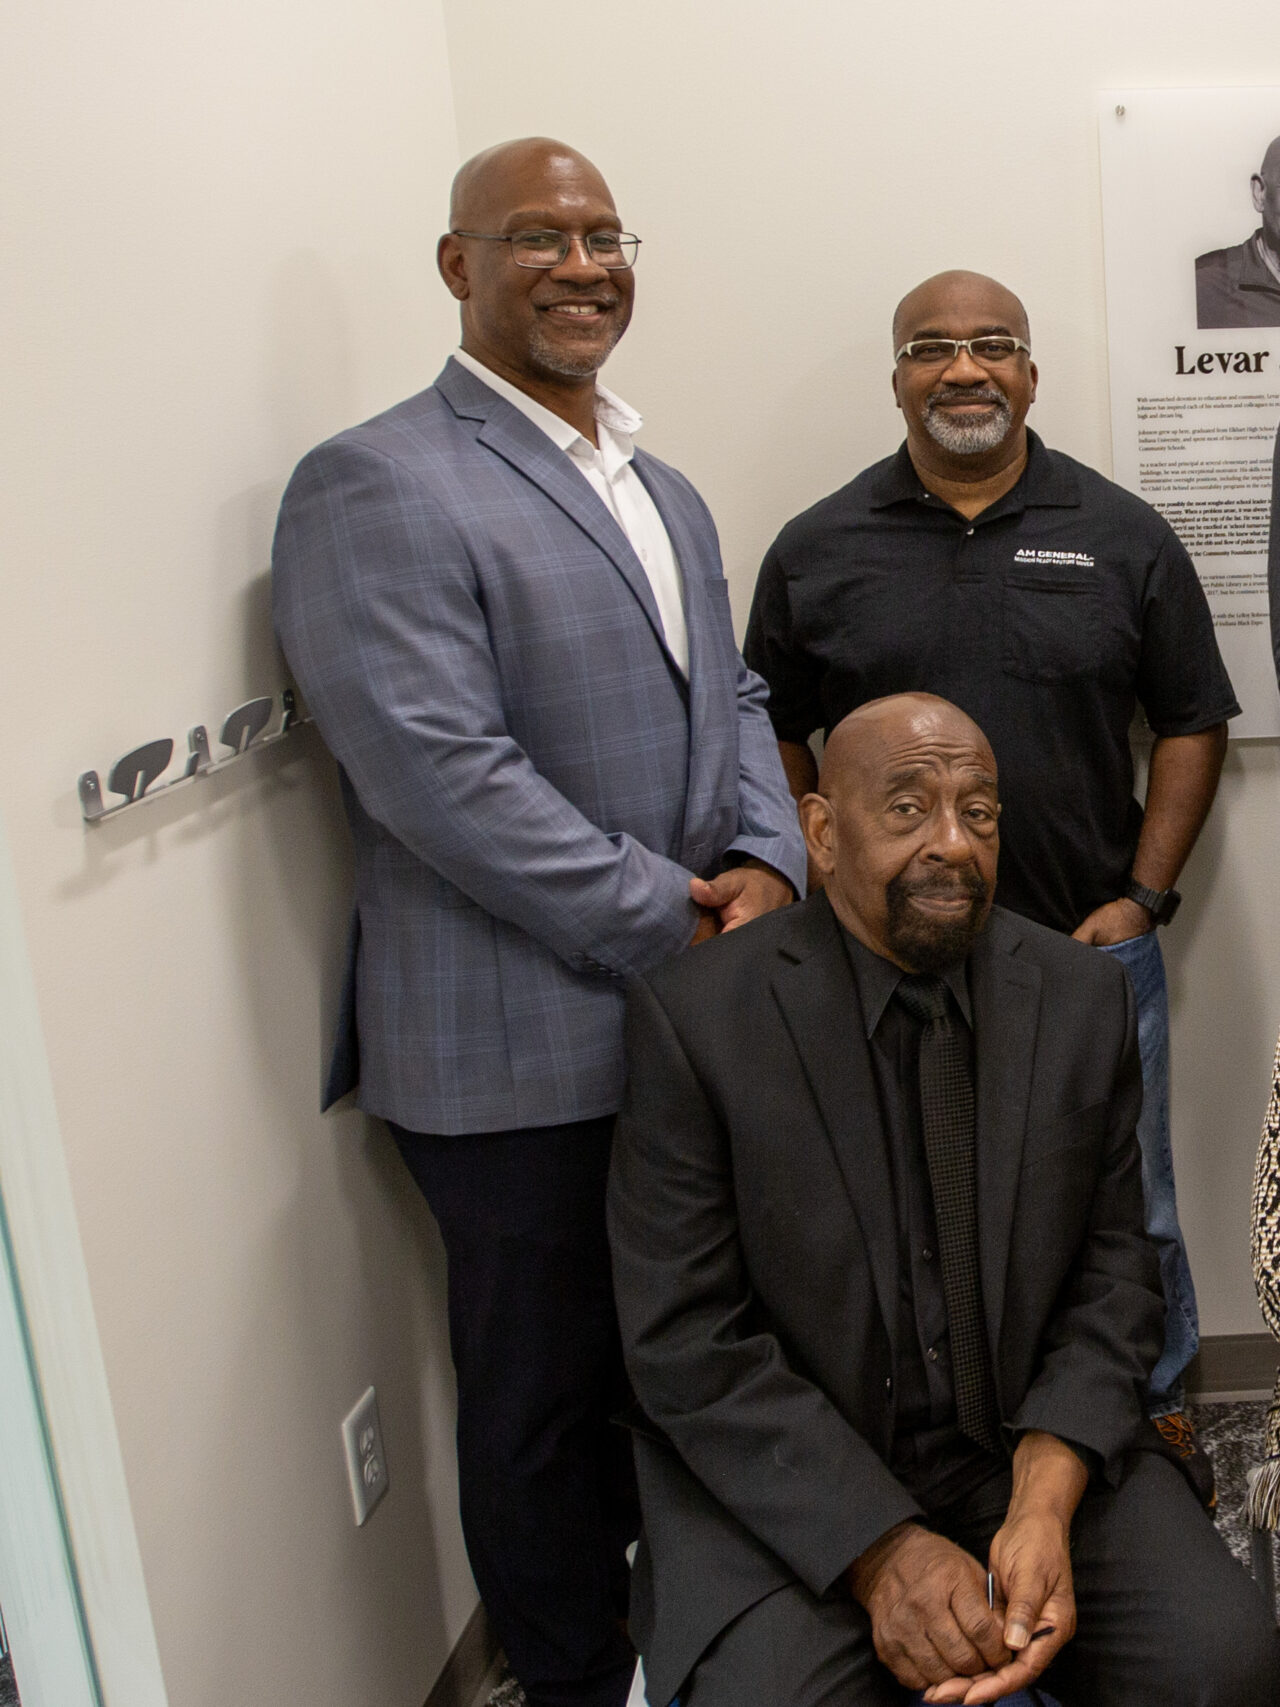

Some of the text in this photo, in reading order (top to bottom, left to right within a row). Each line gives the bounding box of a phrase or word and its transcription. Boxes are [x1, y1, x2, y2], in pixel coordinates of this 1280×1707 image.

[1174, 345, 1270, 375] Levar
[1016, 549, 1036, 557] AM
[1037, 550, 1090, 561] GENERAL
